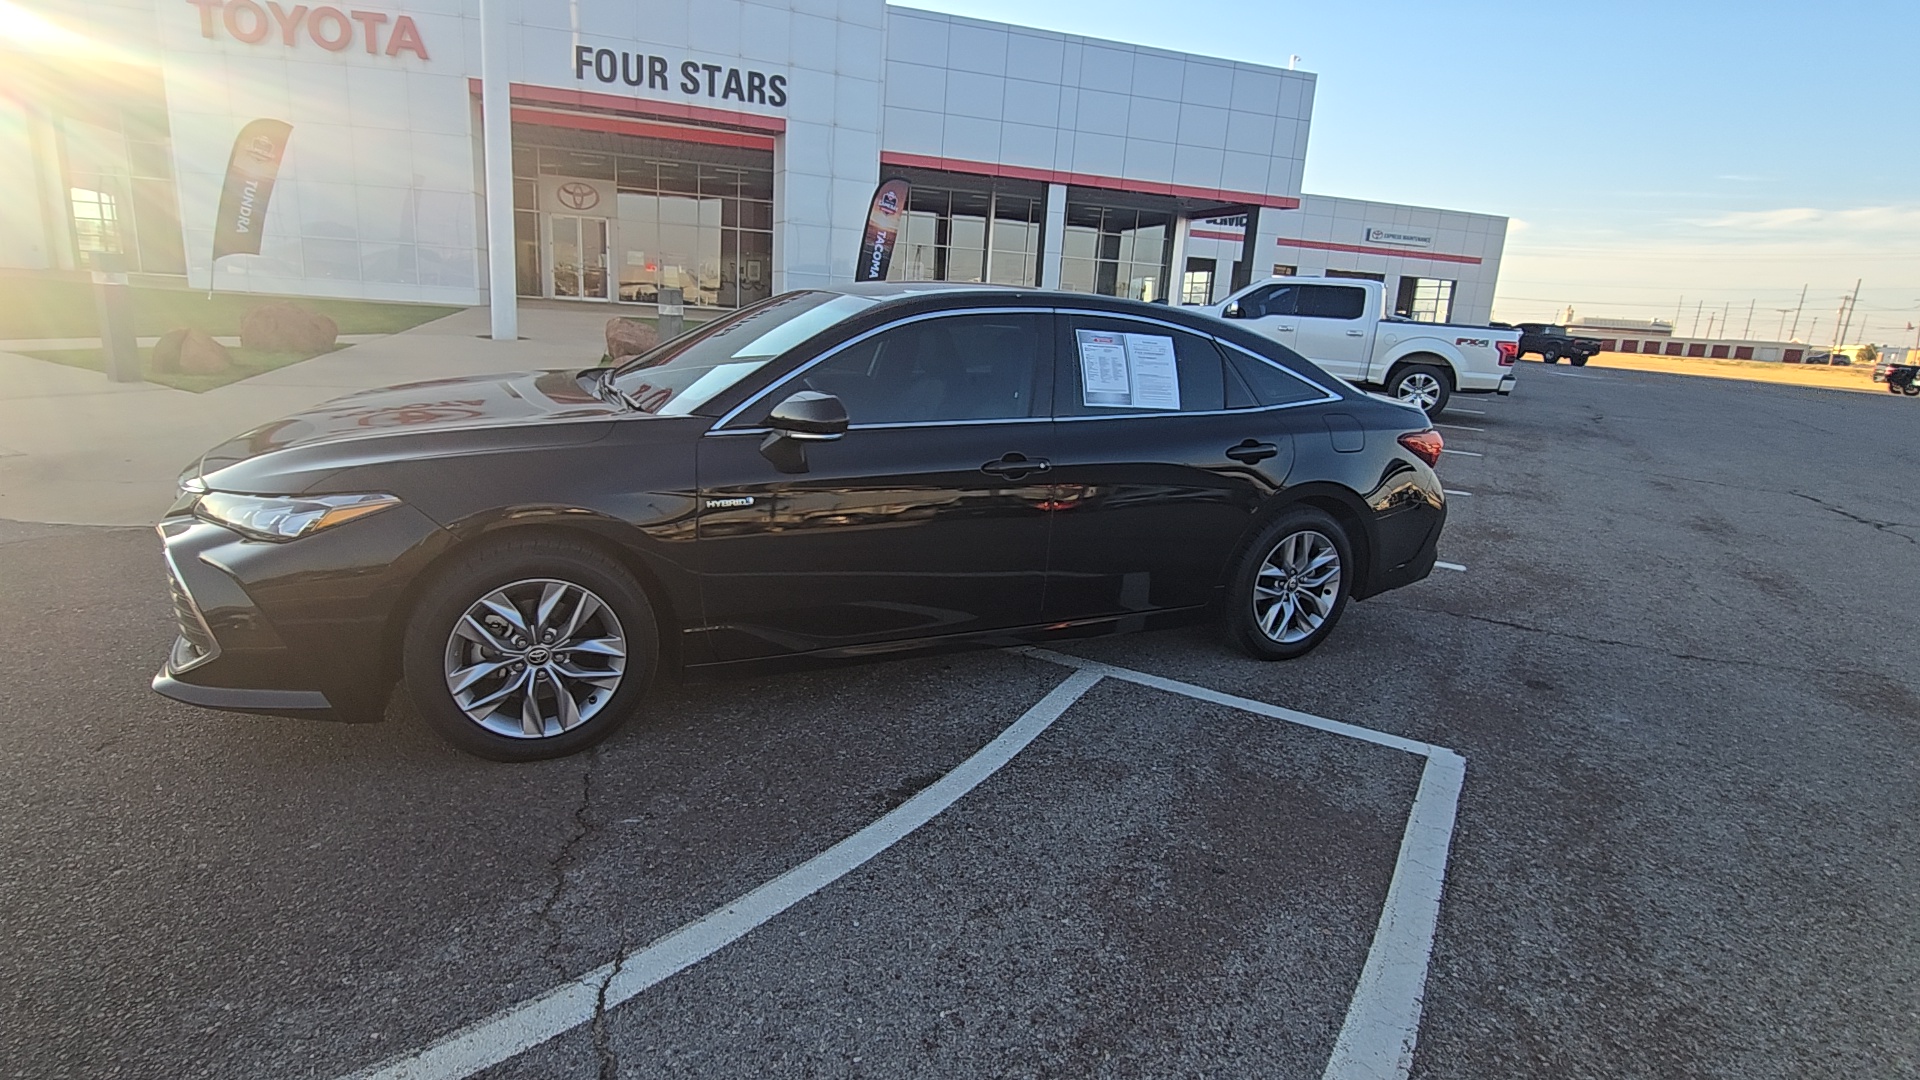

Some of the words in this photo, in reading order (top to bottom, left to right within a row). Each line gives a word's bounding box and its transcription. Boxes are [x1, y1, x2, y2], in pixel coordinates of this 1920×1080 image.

[186, 0, 430, 61] TOYOTA
[575, 44, 669, 91] FOUR
[680, 60, 788, 108] STARS
[236, 180, 258, 233] TUNDRA
[868, 231, 887, 279] TACOMA
[1455, 337, 1490, 348] FX4
[705, 498, 747, 509] HYBRID
